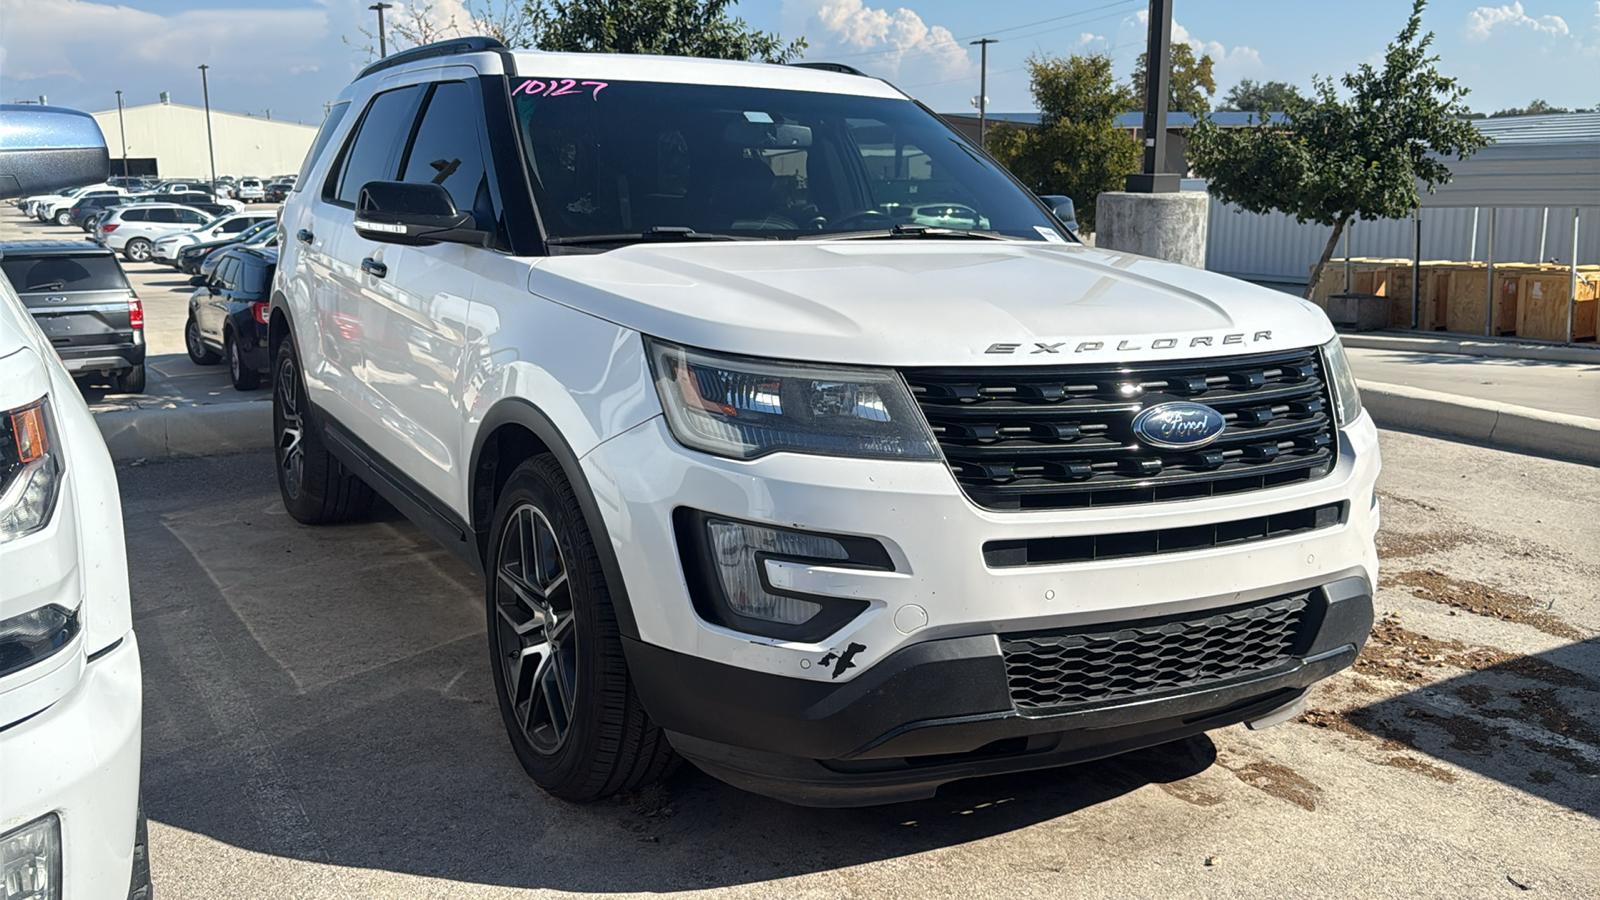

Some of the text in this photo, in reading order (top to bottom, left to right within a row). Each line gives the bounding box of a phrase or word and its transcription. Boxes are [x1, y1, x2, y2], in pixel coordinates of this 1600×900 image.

[511, 79, 609, 102] 10127
[983, 329, 1272, 354] EXPLORER
[1160, 409, 1210, 438] Ford
